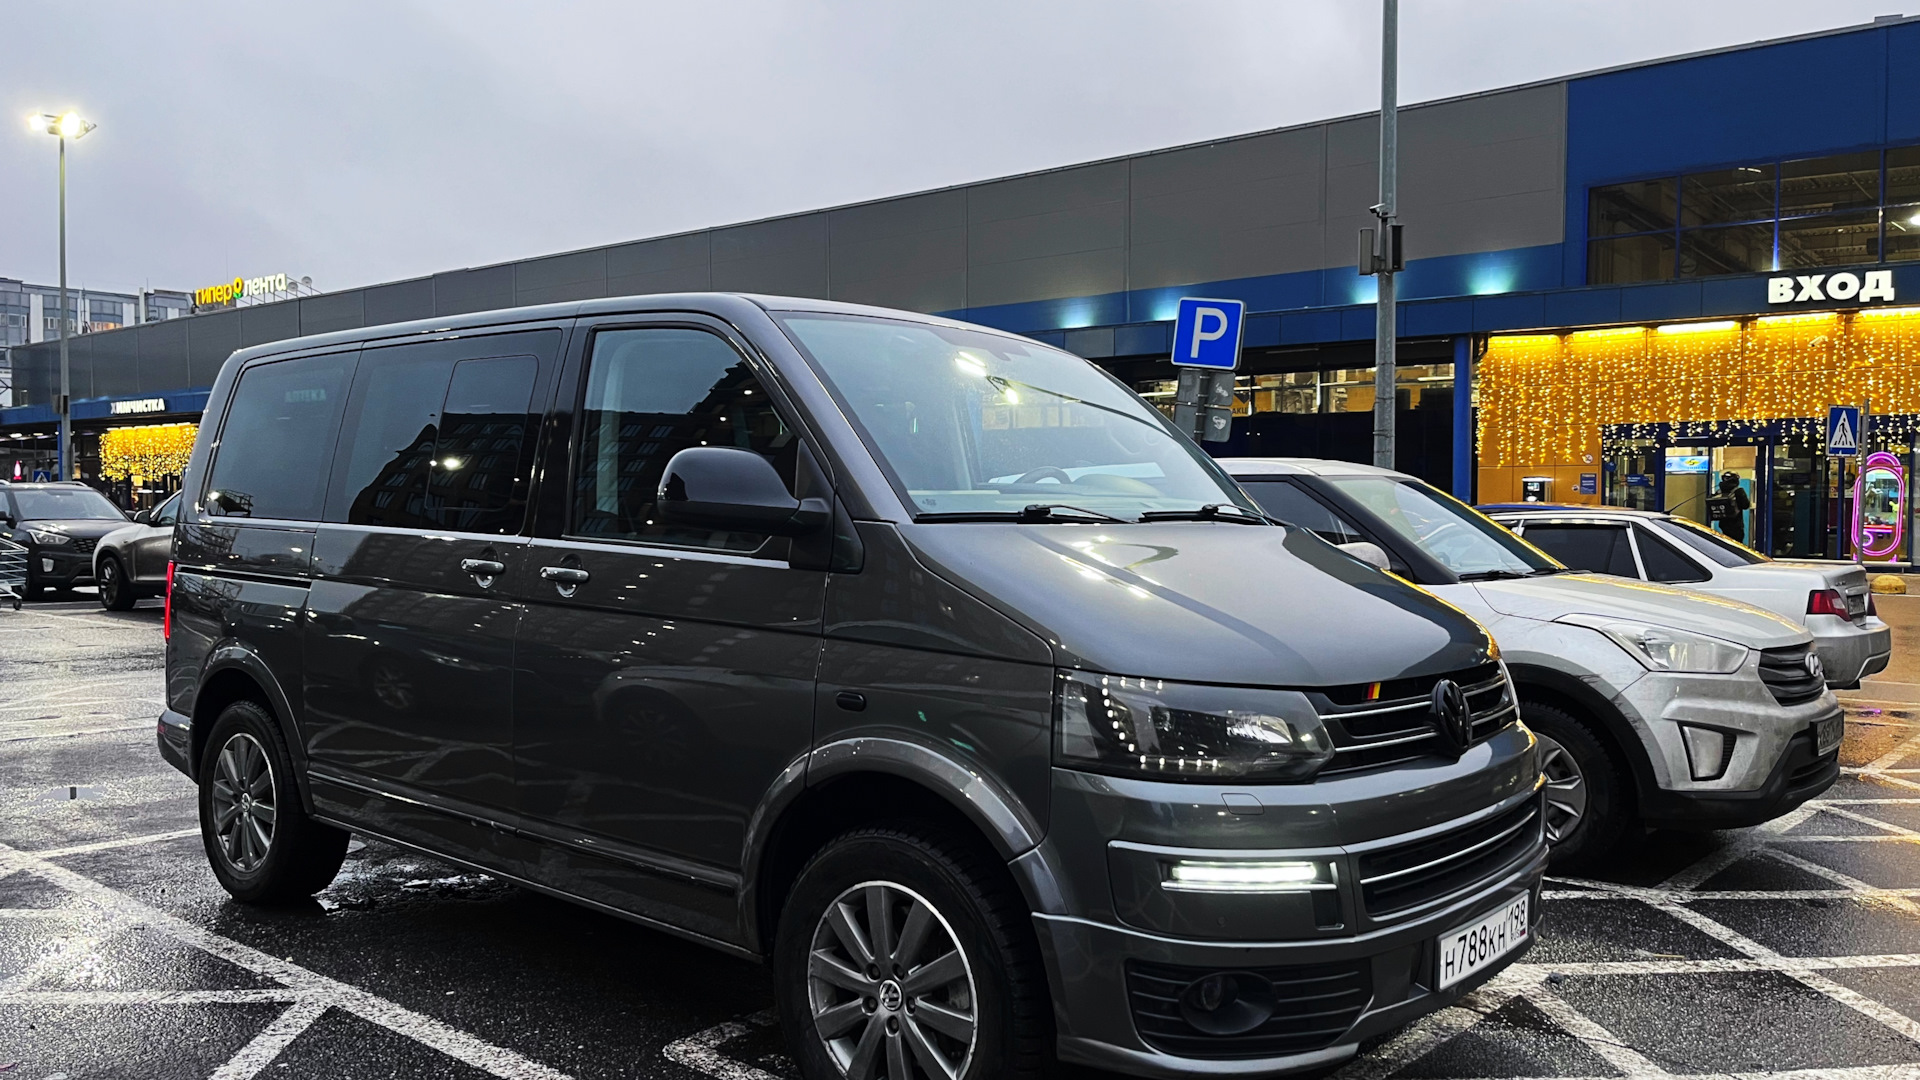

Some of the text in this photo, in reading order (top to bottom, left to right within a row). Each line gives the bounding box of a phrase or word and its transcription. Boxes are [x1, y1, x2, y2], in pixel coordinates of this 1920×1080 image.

[243, 273, 287, 297] лента
[1767, 270, 1895, 304] ВХОД
[1190, 307, 1228, 358] P
[110, 398, 166, 415] ХИМЧИСТКА
[1508, 899, 1527, 932] 198
